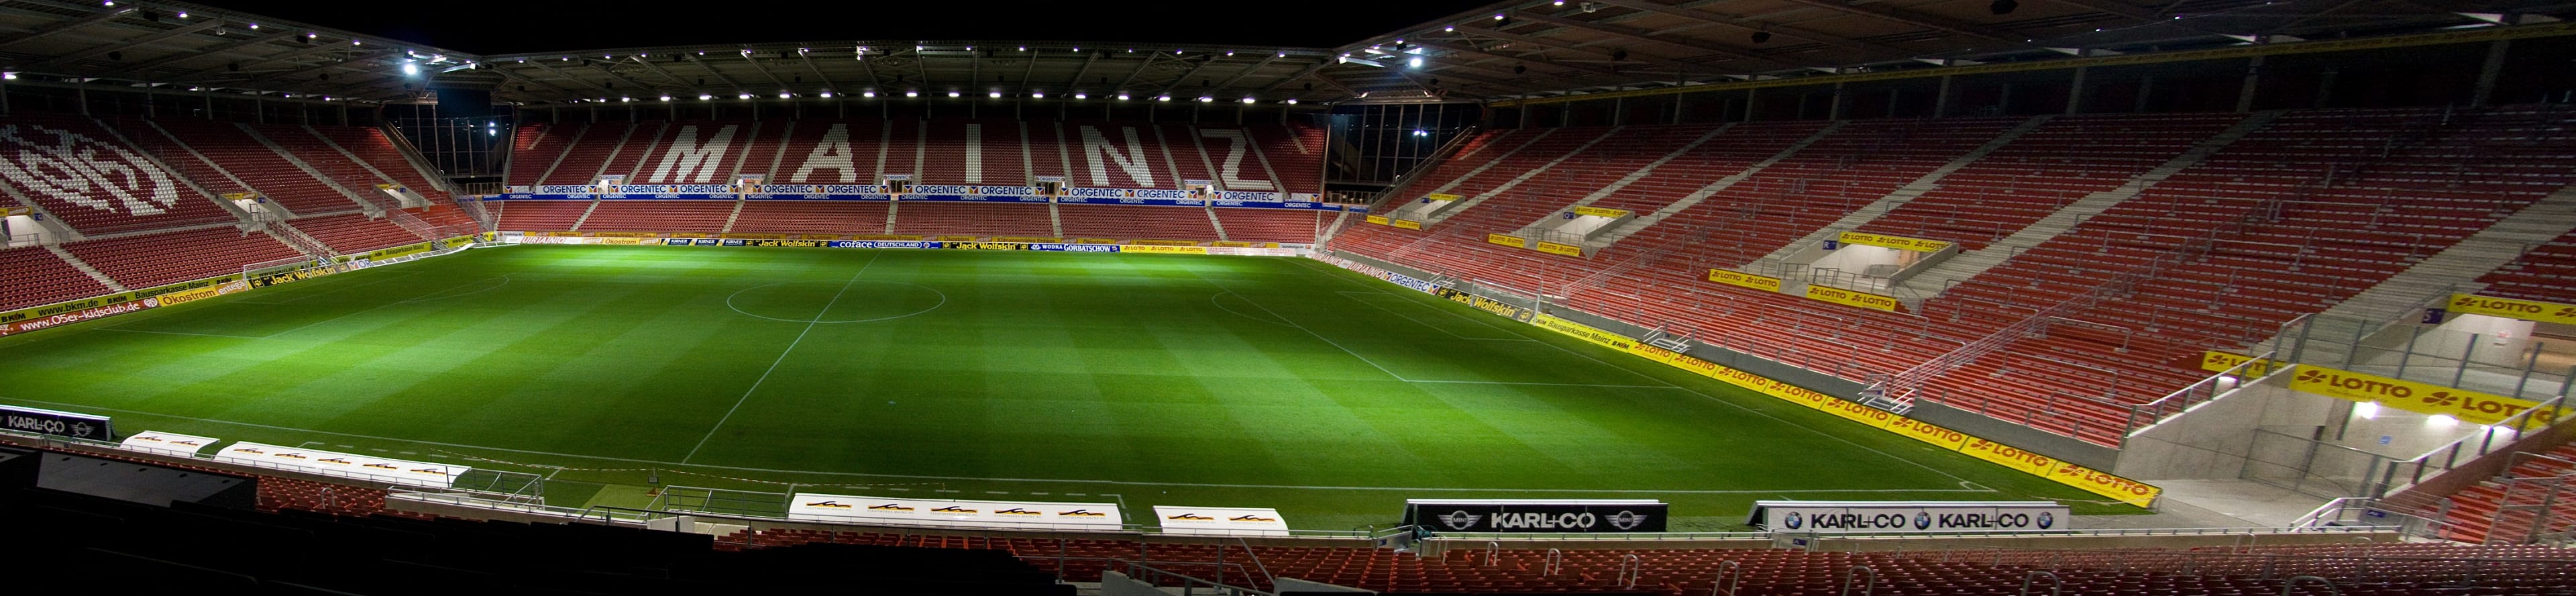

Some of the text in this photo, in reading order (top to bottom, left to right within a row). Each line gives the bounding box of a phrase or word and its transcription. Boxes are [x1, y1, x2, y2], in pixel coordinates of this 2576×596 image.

[648, 123, 1276, 190] MAINZ
[543, 185, 586, 193] ORGENTEC
[621, 185, 666, 193] ORGENTEC
[680, 185, 727, 193] ORGENTEC
[764, 185, 812, 193] ORGENTEC
[826, 185, 876, 194] ORGENTEC
[915, 185, 966, 194] ORGENTEC
[981, 186, 1032, 195] ORGENTEC
[1071, 188, 1122, 197] ORGENTEC
[1224, 192, 1275, 201] ORGENTEC
[956, 242, 1016, 251] Jack Wolfskin
[1064, 244, 1110, 252] GORBATSCHOW
[1886, 237, 1911, 246] LOTTO
[270, 273, 294, 285] Jack
[295, 266, 337, 281] Wolfskin
[1390, 273, 1430, 291] ORGENTEC
[1720, 272, 1777, 287] LOTTO LOTTO
[218, 281, 246, 295] entega
[38, 299, 99, 317] www.bkm.de
[135, 283, 187, 301] Bausparkasse
[188, 280, 209, 290] Mainz
[162, 290, 216, 306] Ökostrom
[1451, 292, 1515, 317] Jack Wolfskin
[1820, 289, 1892, 307] LOTTO LOTTO
[2480, 299, 2542, 314] LOTTO
[1548, 320, 1590, 339] Bausparkasse
[1590, 333, 1611, 344] Mainz
[1645, 345, 1670, 358] LOTTO
[1686, 356, 1715, 370] LOTTO
[1732, 370, 1766, 386] LOTTO
[1784, 385, 1823, 403] LOTTO
[2329, 375, 2412, 398] LOTTO
[1844, 401, 1888, 421] LOTTO
[1912, 421, 1962, 443] LOTTO
[1992, 444, 2048, 466] LOTTO
[2084, 470, 2149, 495] LOTTO
[1491, 512, 1596, 528] KARL+CO
[1811, 513, 2029, 529] KARL+CO KARL+CO
